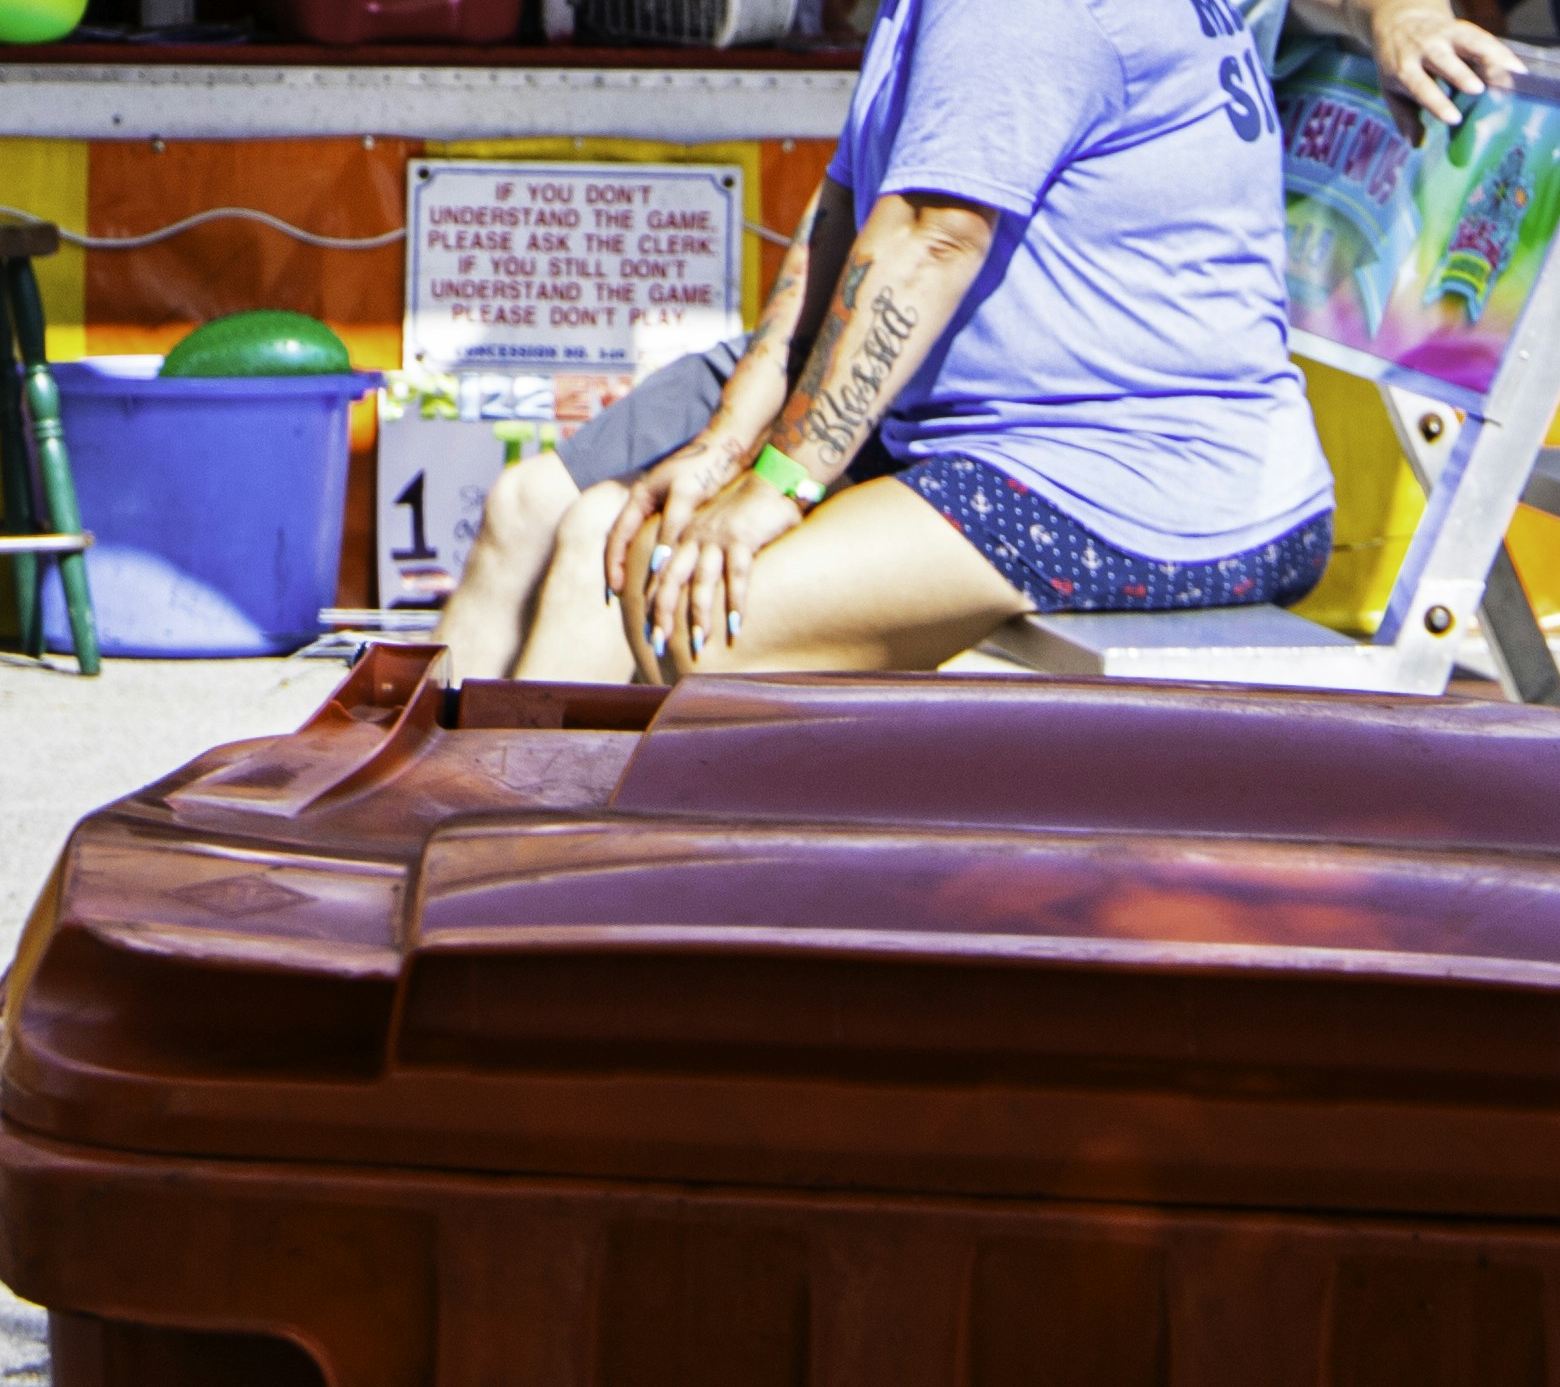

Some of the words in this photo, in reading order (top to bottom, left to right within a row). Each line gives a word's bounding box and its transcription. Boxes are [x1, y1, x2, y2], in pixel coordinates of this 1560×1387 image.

[495, 182, 514, 202] IF
[528, 183, 574, 203] YOU
[586, 184, 653, 204] DON'T
[429, 206, 580, 228] UNDERSTAND
[594, 209, 634, 229] THE
[428, 230, 512, 251] PLEASE
[526, 232, 570, 252] ASK
[585, 233, 625, 254] THE
[457, 255, 476, 274] IF
[490, 255, 536, 277] YOU
[548, 257, 607, 278] STILL
[620, 258, 687, 280] DON'T
[431, 279, 581, 301] UNDERSTAND
[596, 282, 635, 302] THE
[452, 303, 536, 325] PLEASE
[550, 305, 616, 326] DON'T
[806, 284, 918, 466] Blessed
[390, 468, 437, 560] 1
